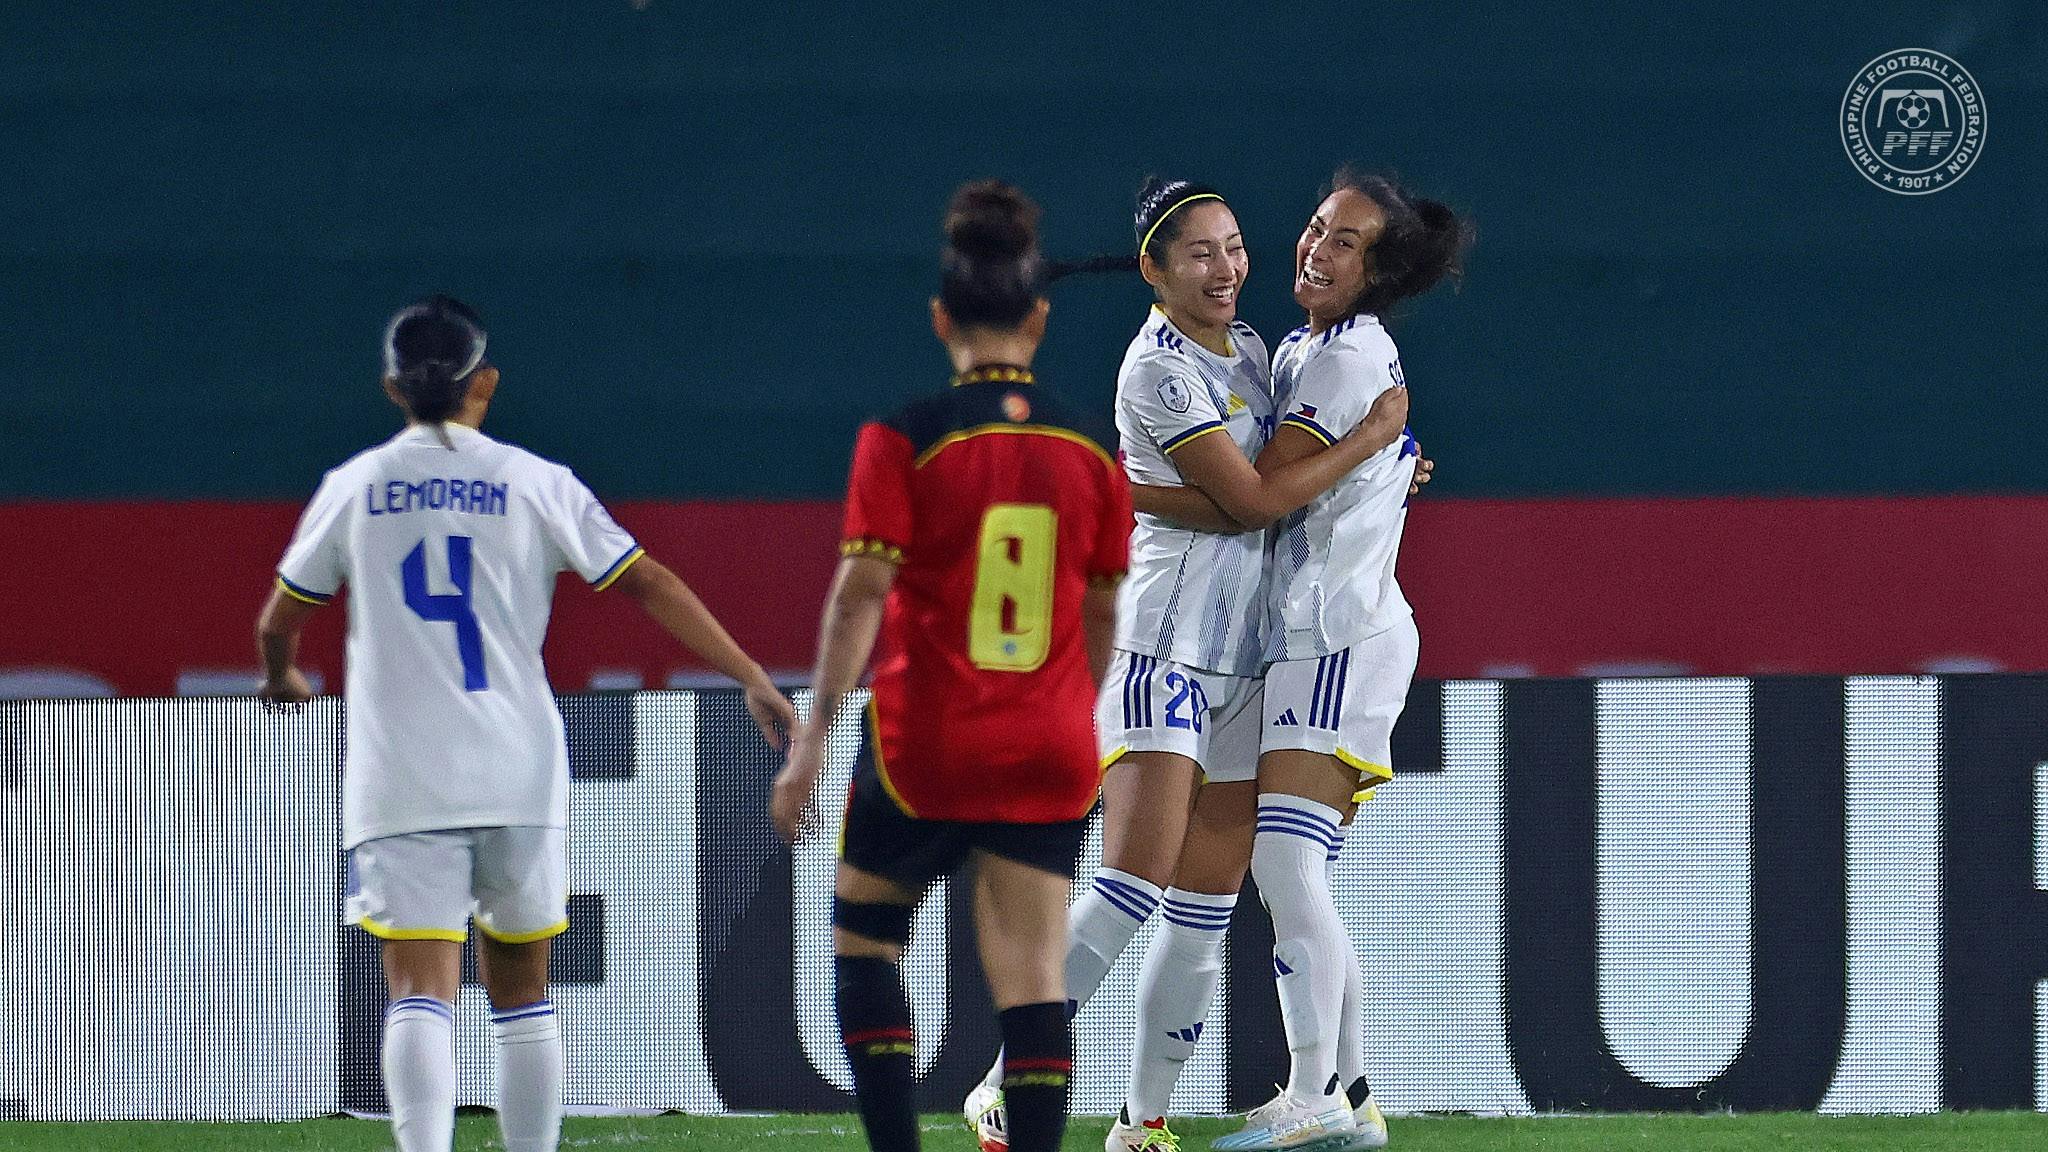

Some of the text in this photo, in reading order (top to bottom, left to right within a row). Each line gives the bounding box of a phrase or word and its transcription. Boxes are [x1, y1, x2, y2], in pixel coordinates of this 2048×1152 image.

[366, 478, 508, 517] LEMORAN
[402, 535, 489, 693] 4
[968, 503, 1060, 673] 8
[1165, 671, 1209, 735] 20
